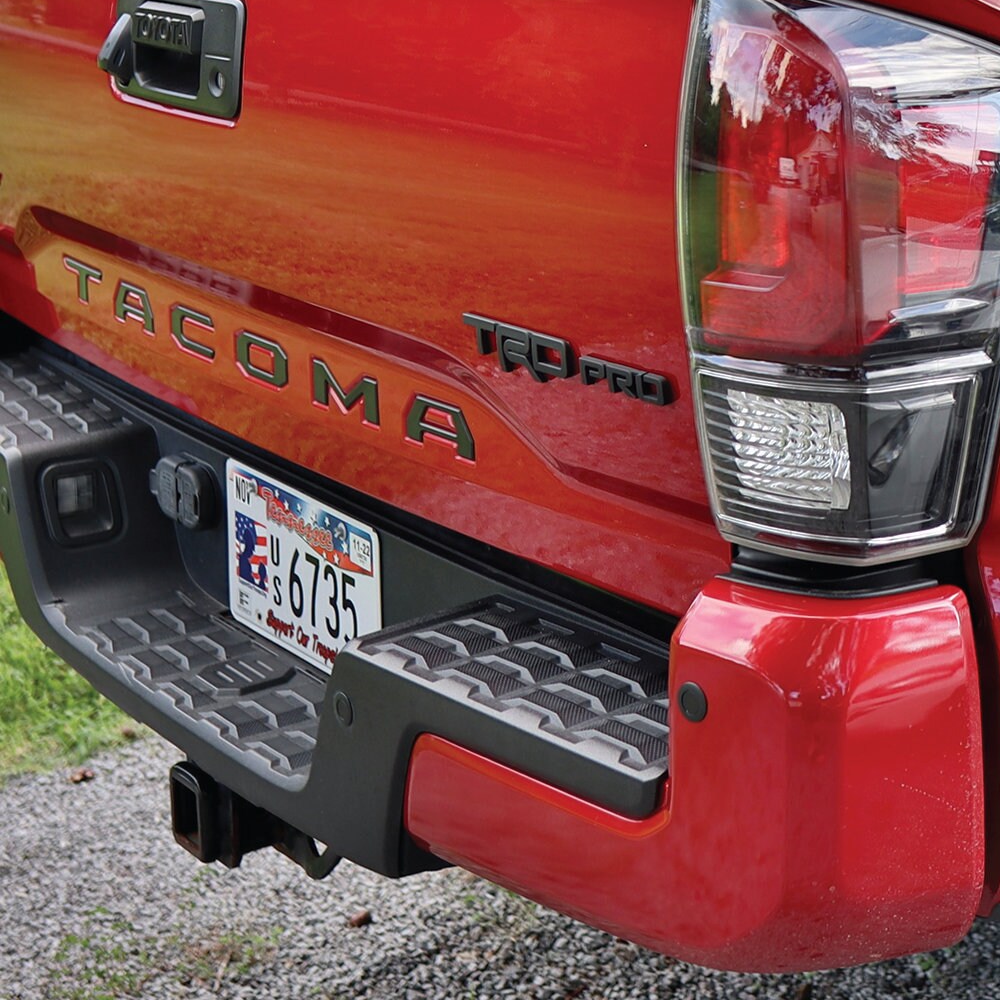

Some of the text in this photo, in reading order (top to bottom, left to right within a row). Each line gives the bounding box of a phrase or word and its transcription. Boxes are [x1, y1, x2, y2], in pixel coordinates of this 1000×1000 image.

[135, 12, 190, 48] TOYOTA
[62, 254, 477, 465] TACOMA
[462, 312, 673, 406] TRD PRO
[262, 485, 334, 551] Tennessee
[289, 549, 358, 643] 6735
